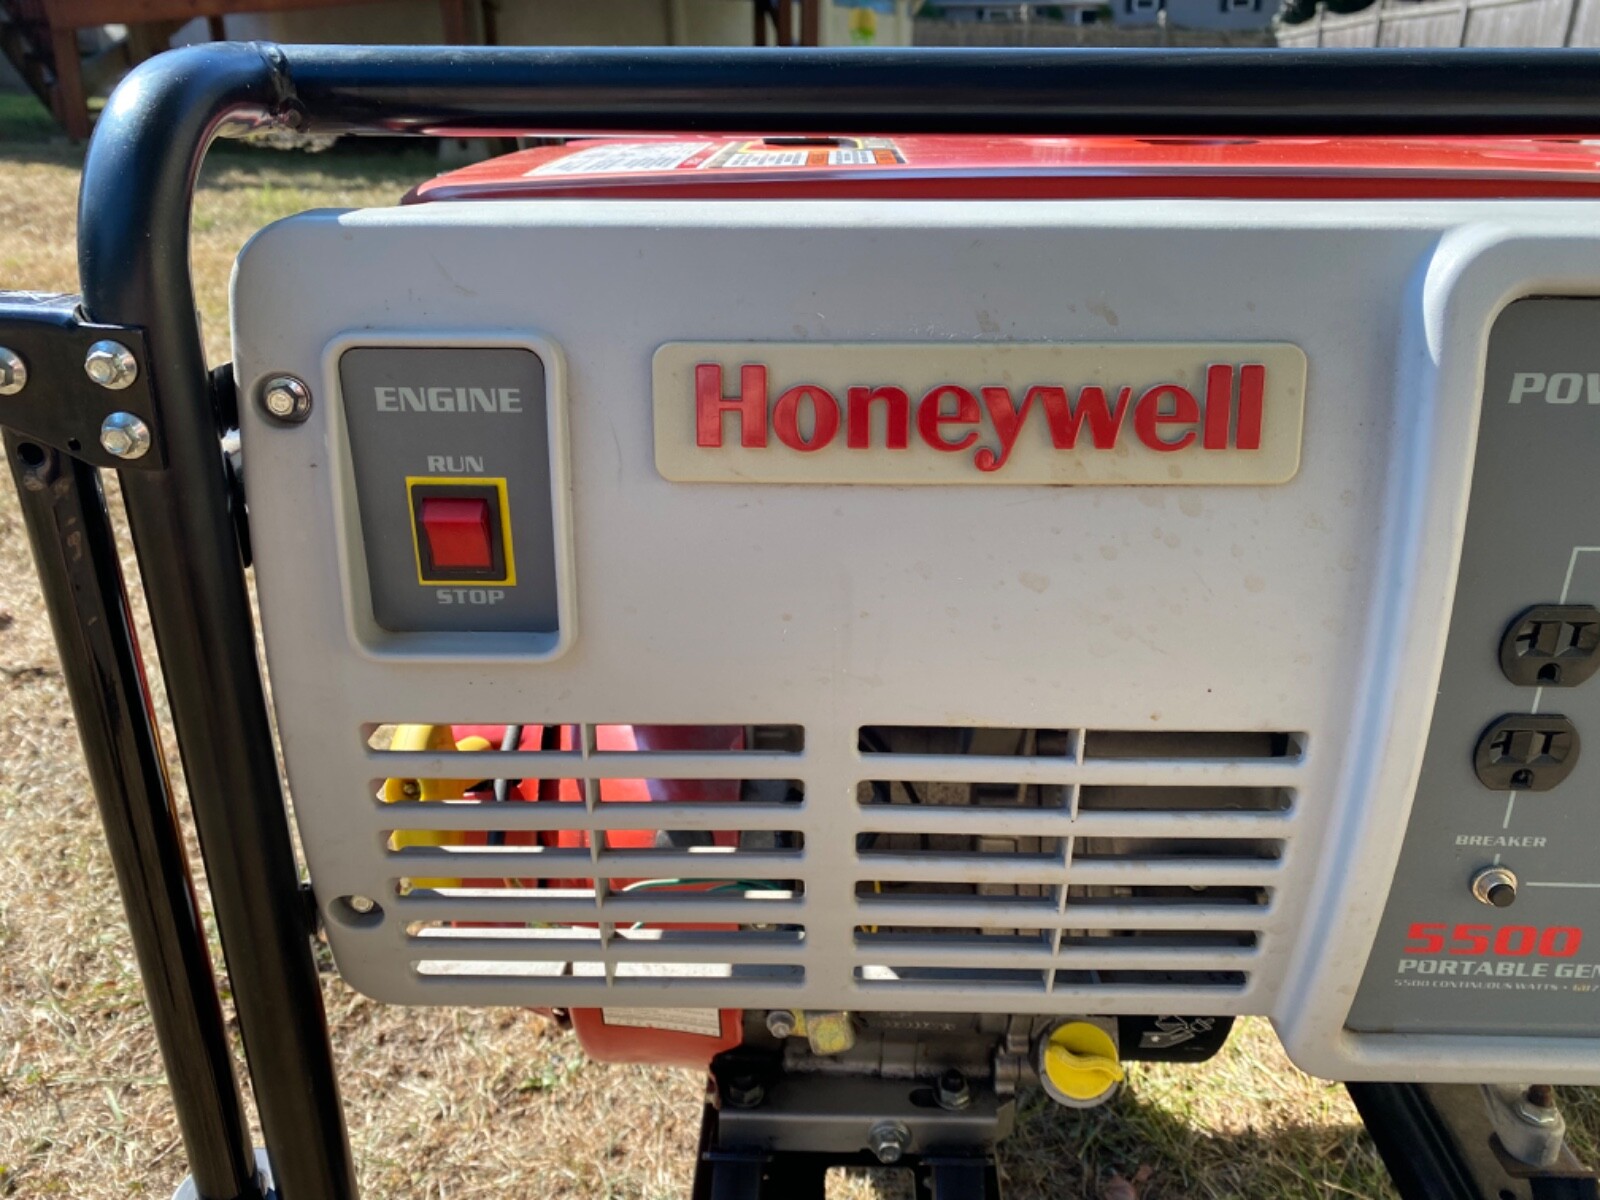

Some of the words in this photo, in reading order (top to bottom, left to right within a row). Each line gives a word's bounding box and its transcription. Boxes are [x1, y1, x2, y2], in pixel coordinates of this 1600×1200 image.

[374, 386, 523, 413] ENGINE
[695, 363, 1266, 472] Honeywell
[427, 455, 484, 472] RUN
[436, 589, 505, 605] STOP
[1455, 834, 1547, 848] BREAKER
[1403, 922, 1583, 958] 5500
[1398, 959, 1549, 978] PORTABLE
[1394, 978, 1430, 988] 5500
[1432, 979, 1513, 990] CONTINUOUS
[1515, 981, 1558, 991] WATTS
